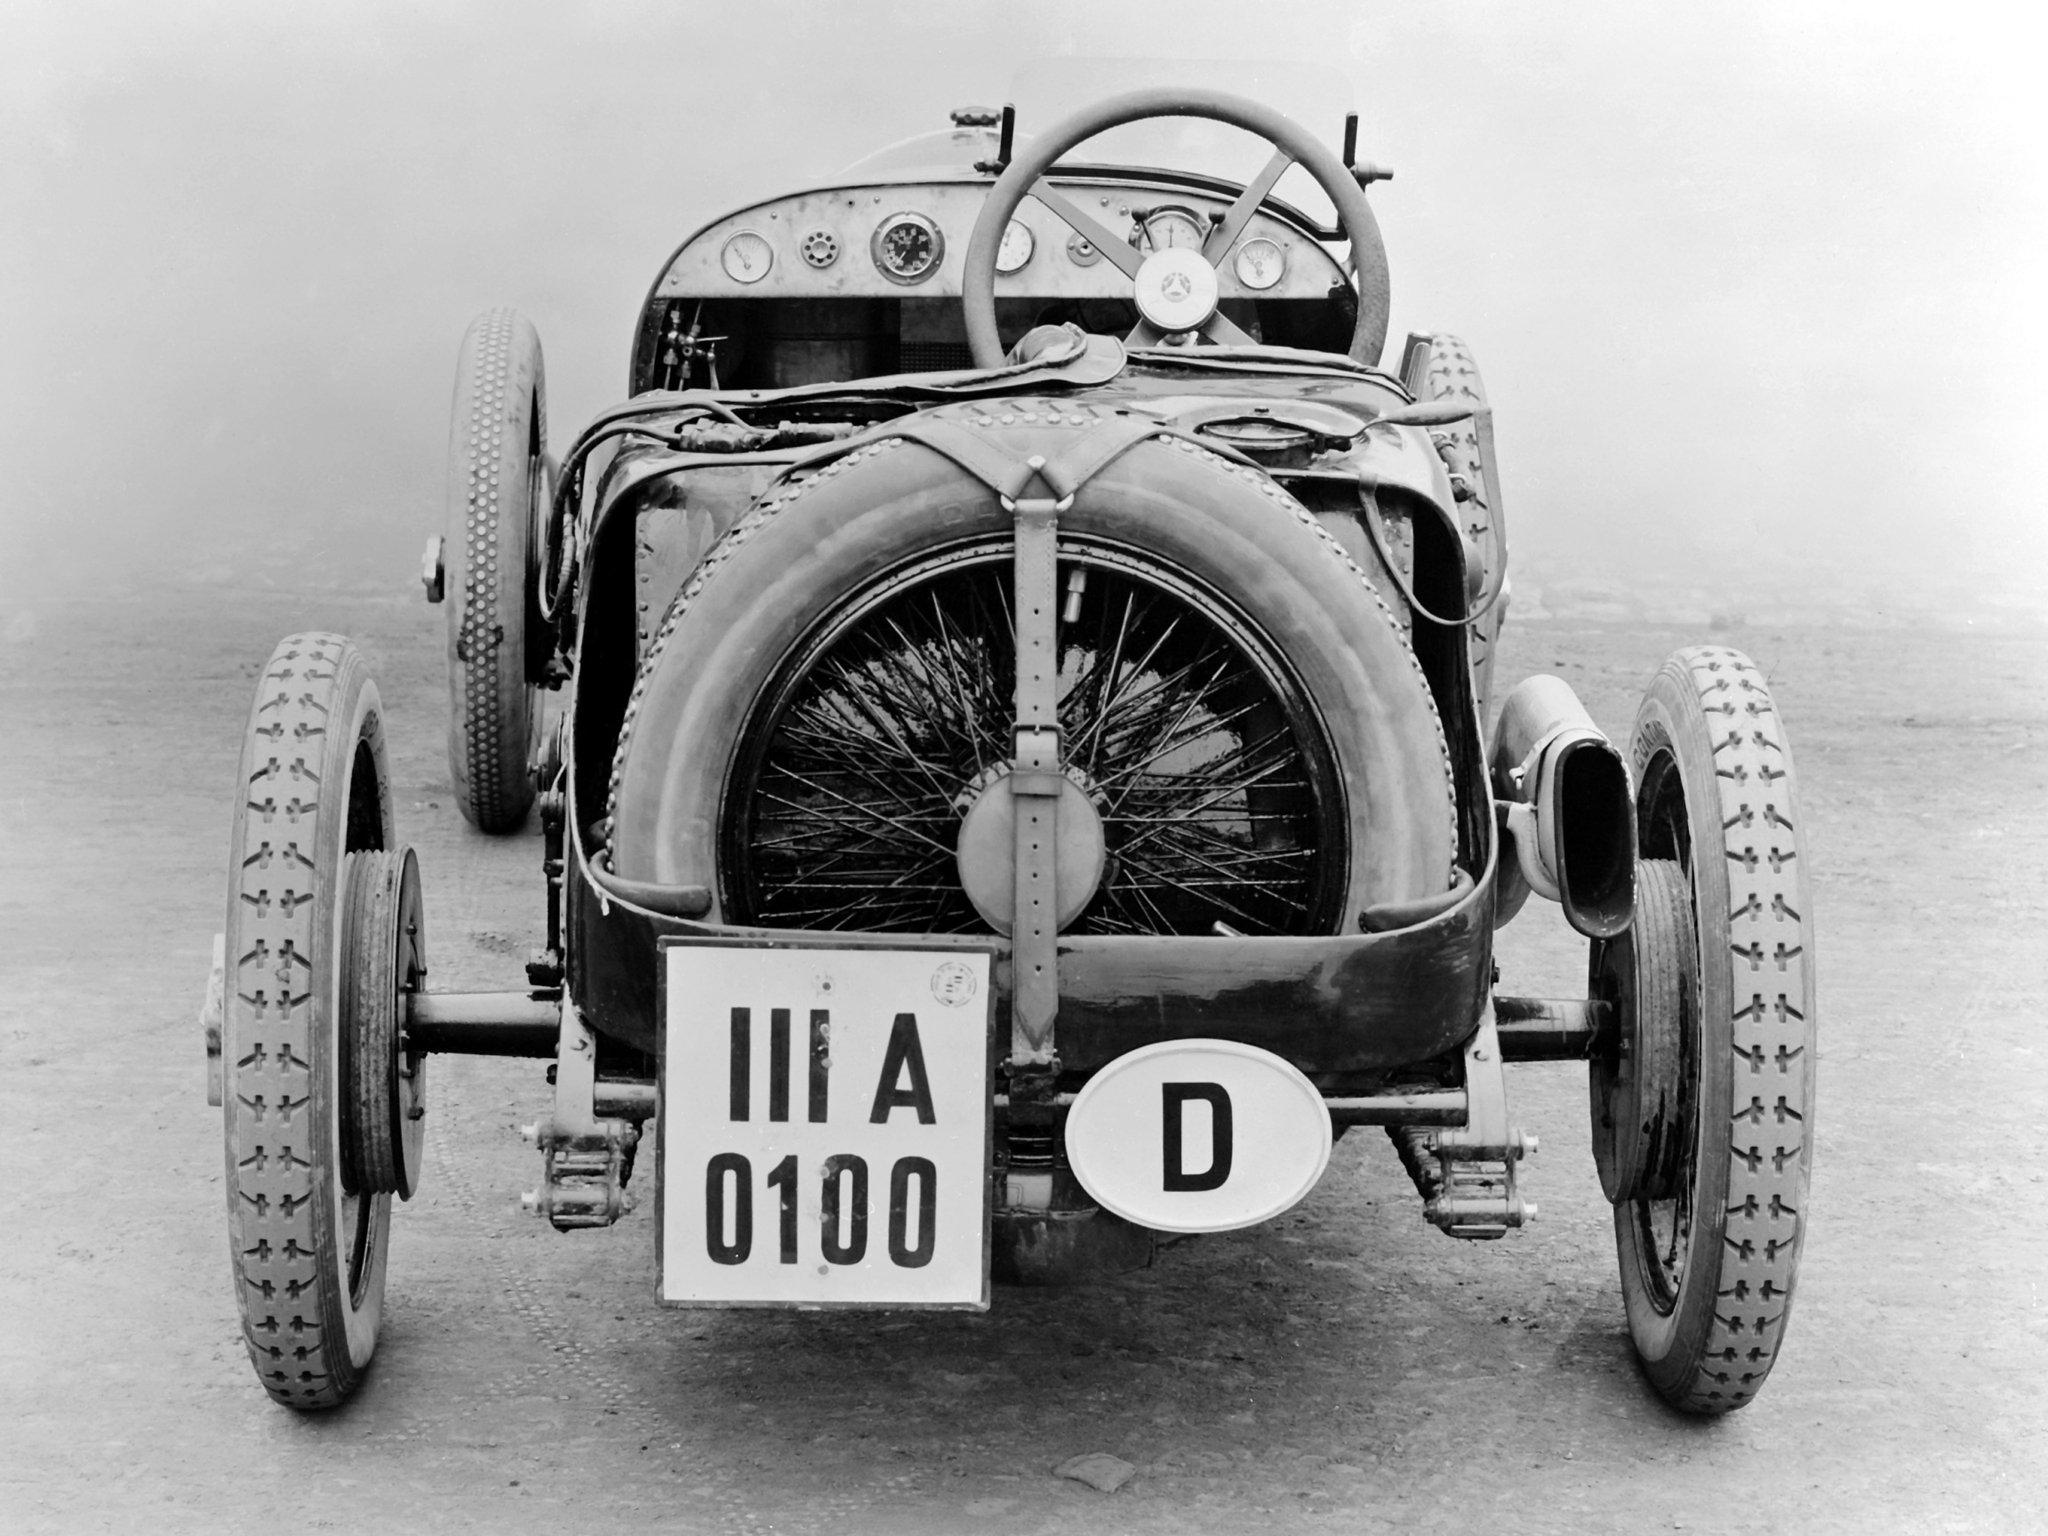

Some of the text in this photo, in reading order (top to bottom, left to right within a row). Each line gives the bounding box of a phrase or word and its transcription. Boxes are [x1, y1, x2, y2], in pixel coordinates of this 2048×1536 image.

[730, 1008, 936, 1124] III A
[1163, 1083, 1232, 1192] D
[706, 1153, 936, 1268] 0100
